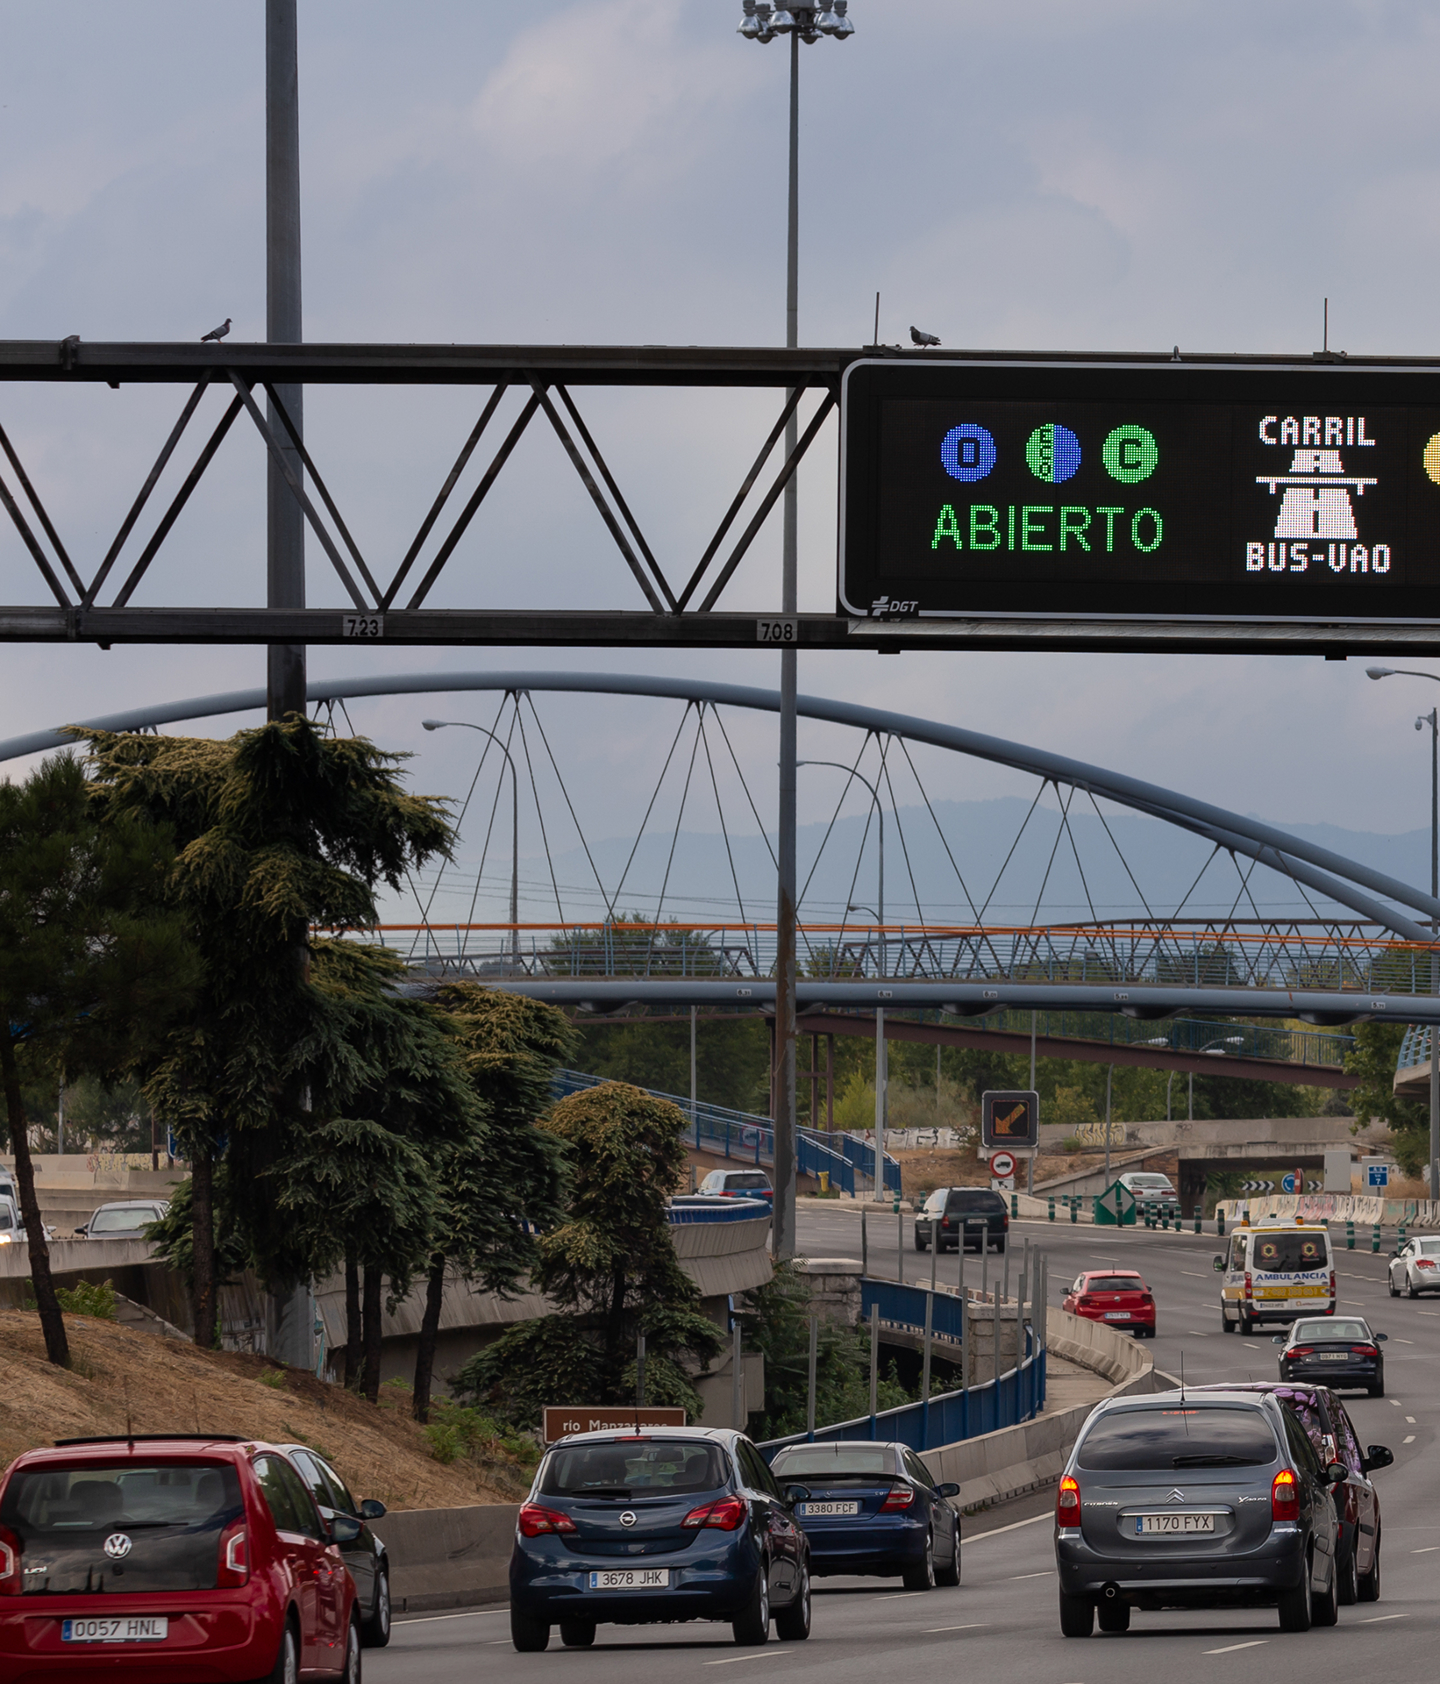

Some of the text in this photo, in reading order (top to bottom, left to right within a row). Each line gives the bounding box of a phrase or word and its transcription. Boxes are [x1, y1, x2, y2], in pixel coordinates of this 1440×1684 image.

[1258, 416, 1376, 446] CARRIL
[1119, 439, 1142, 470] C
[931, 504, 1163, 552] ABIERTO
[1246, 542, 1391, 573] BUS-VAO
[889, 600, 919, 612] DGT
[347, 619, 379, 637] 7,23
[761, 623, 793, 641] 7,08
[1255, 1272, 1328, 1281] AMBULANCIA
[563, 1419, 581, 1432] río
[808, 1503, 855, 1514] 3380 FCF
[1147, 1515, 1210, 1531] 1170 FYX
[602, 1571, 662, 1586] 3678 JHK
[75, 1619, 162, 1637] 0057 HNL
